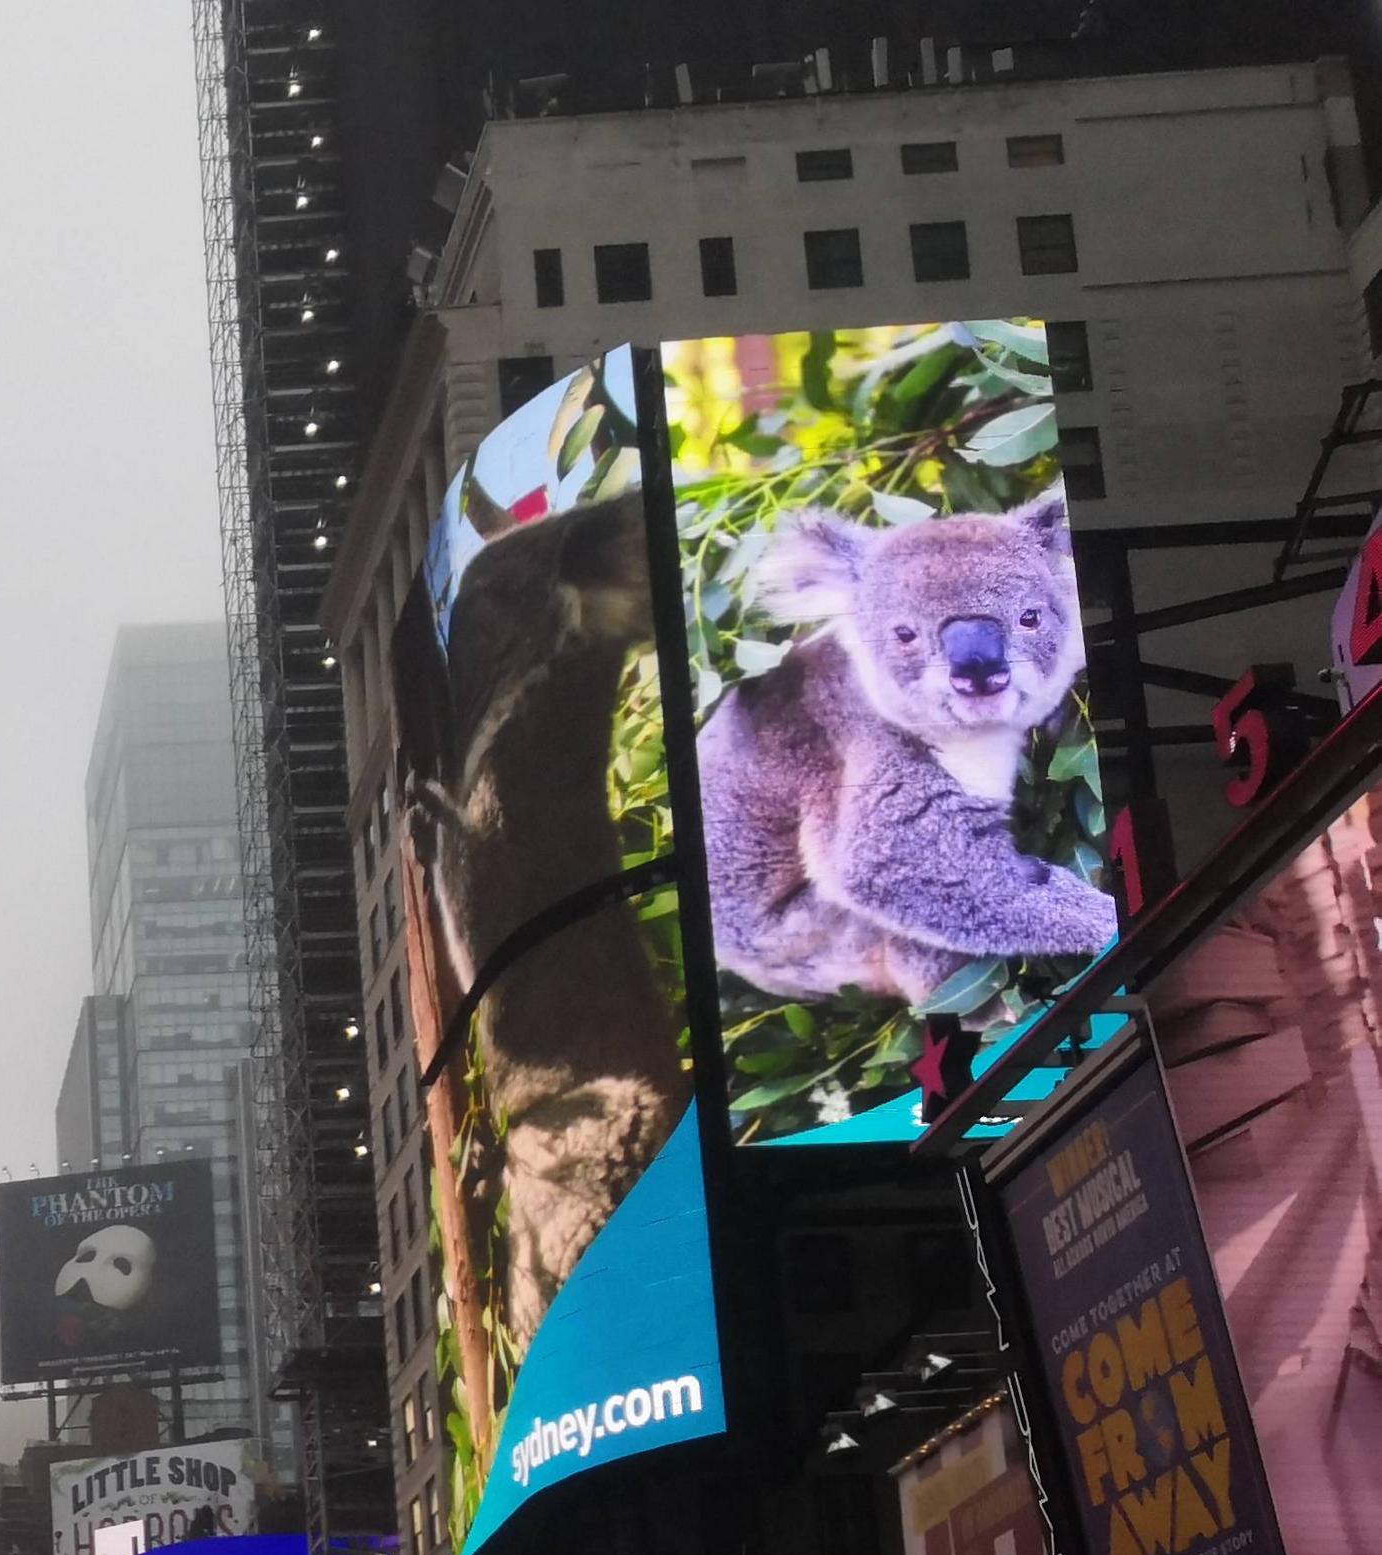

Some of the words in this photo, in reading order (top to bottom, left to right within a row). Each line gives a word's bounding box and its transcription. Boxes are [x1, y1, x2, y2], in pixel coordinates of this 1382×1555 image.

[31, 1180, 175, 1217] PHANTOM
[1051, 1314, 1089, 1355] COME
[1089, 1262, 1163, 1327] TOGETHER
[1165, 1246, 1184, 1273] AT
[1062, 1277, 1204, 1426] COME
[512, 1371, 702, 1488] sydney.com
[72, 1456, 161, 1515] LITTLE
[169, 1456, 237, 1498] SHOP
